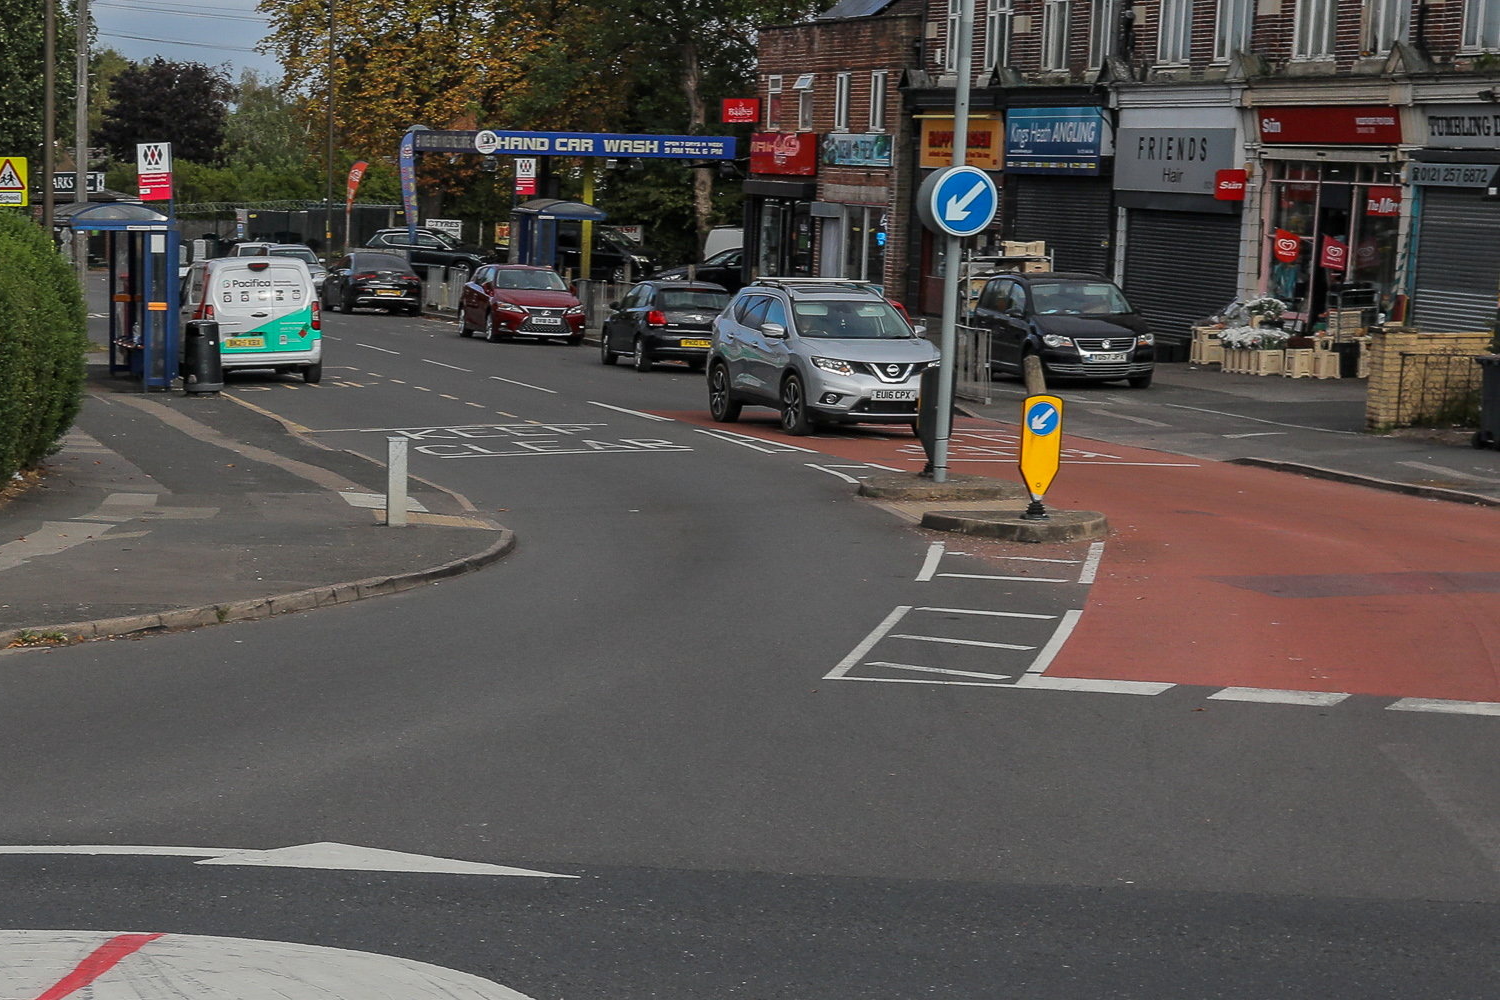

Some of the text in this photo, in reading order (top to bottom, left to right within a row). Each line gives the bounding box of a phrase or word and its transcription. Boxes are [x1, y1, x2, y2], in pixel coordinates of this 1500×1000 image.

[1428, 115, 1491, 137] TUMBLING
[1009, 122, 1029, 149] Kings
[1052, 122, 1097, 143] ANGLING
[497, 136, 659, 153] HAND CAR WASH
[1138, 136, 1208, 161] FRIENDS
[1162, 168, 1184, 183] Hair
[1420, 167, 1488, 183] 0121 257 6872
[0, 193, 20, 201] School
[1367, 199, 1379, 211] The
[233, 278, 271, 288] Pacifica
[875, 391, 911, 399] EU16 CPX
[394, 424, 591, 440] KEEP
[414, 438, 693, 456] CLEAR
